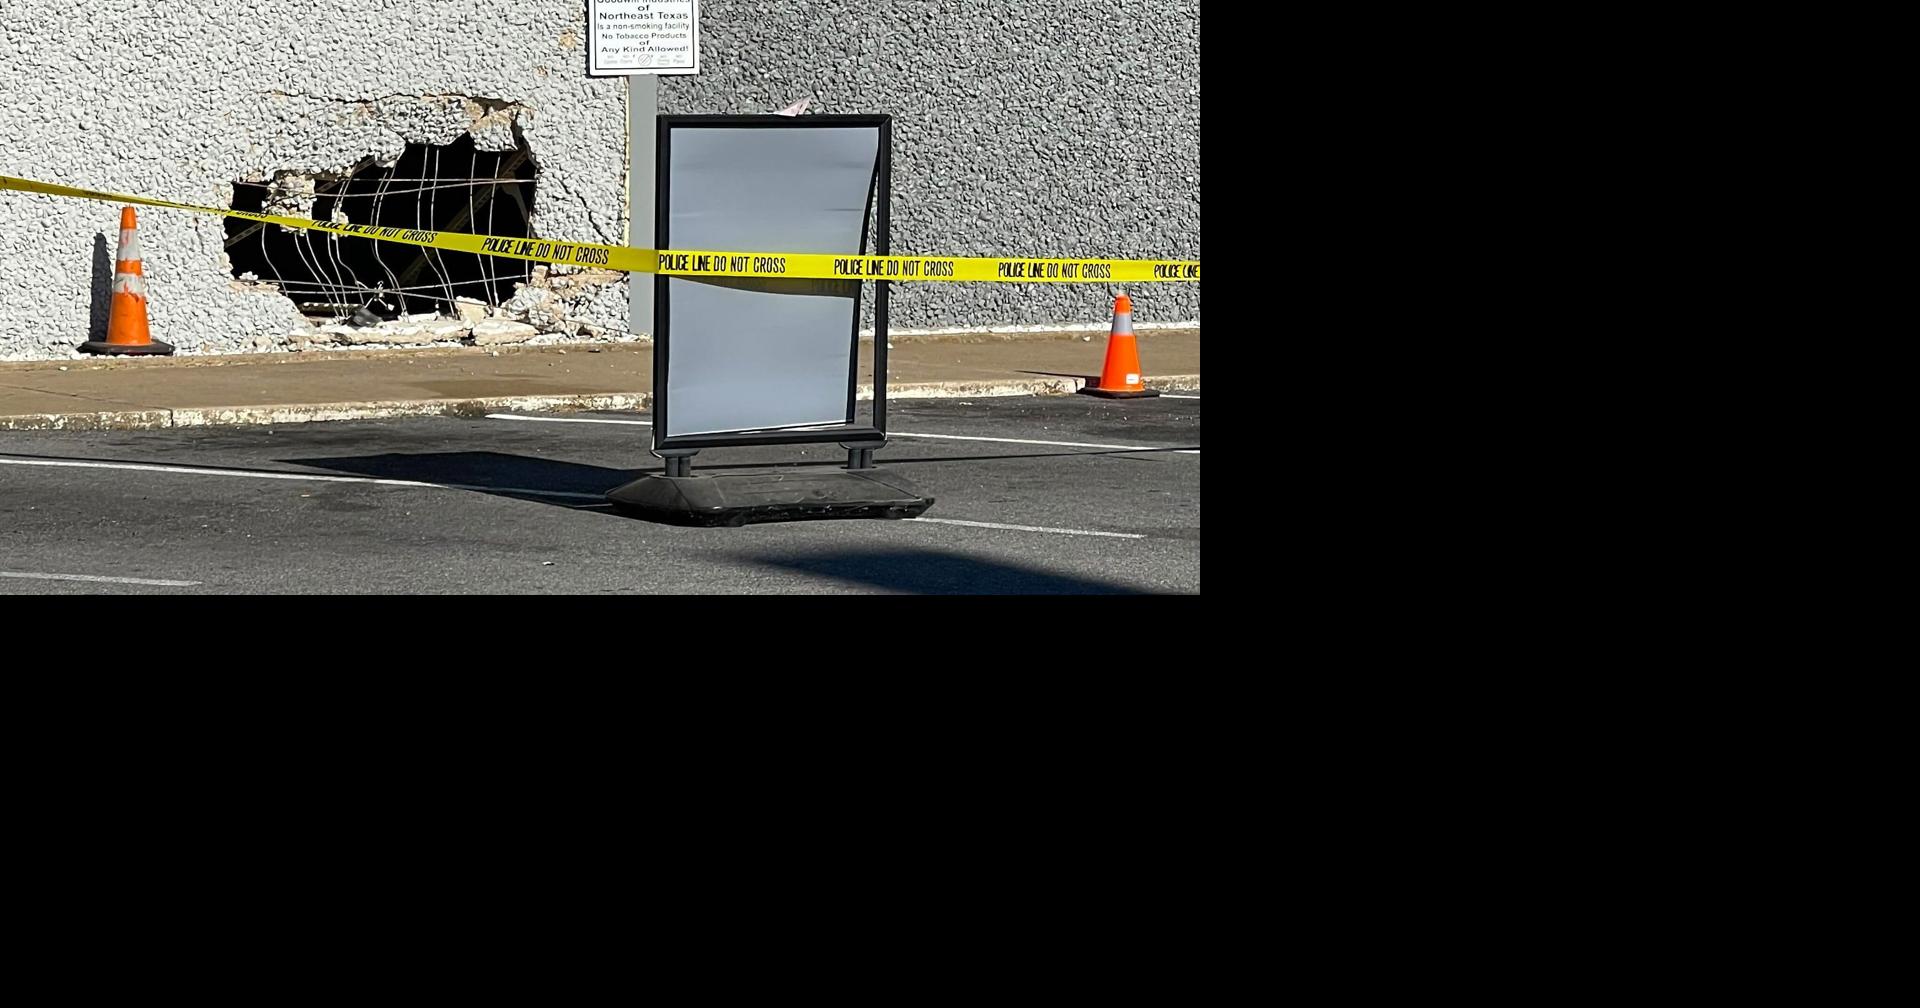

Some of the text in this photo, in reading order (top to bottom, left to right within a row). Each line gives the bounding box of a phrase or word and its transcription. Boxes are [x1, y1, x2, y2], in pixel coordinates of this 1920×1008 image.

[600, 12, 688, 20] Northeast Texas
[613, 23, 662, 31] non-smoking
[363, 226, 380, 235] DO
[379, 227, 400, 238] NOT
[402, 230, 438, 243] CROSS
[482, 238, 609, 264] POLICE LINE DO NOT CROSS
[659, 254, 786, 273] POLICE LINE DO NOT CROSS
[834, 259, 954, 276] POLICE LINE DO NOT CROSS
[998, 262, 1111, 278] POLICE LINE DO NOT CROSS
[1154, 264, 1200, 278] POLICE LINE
